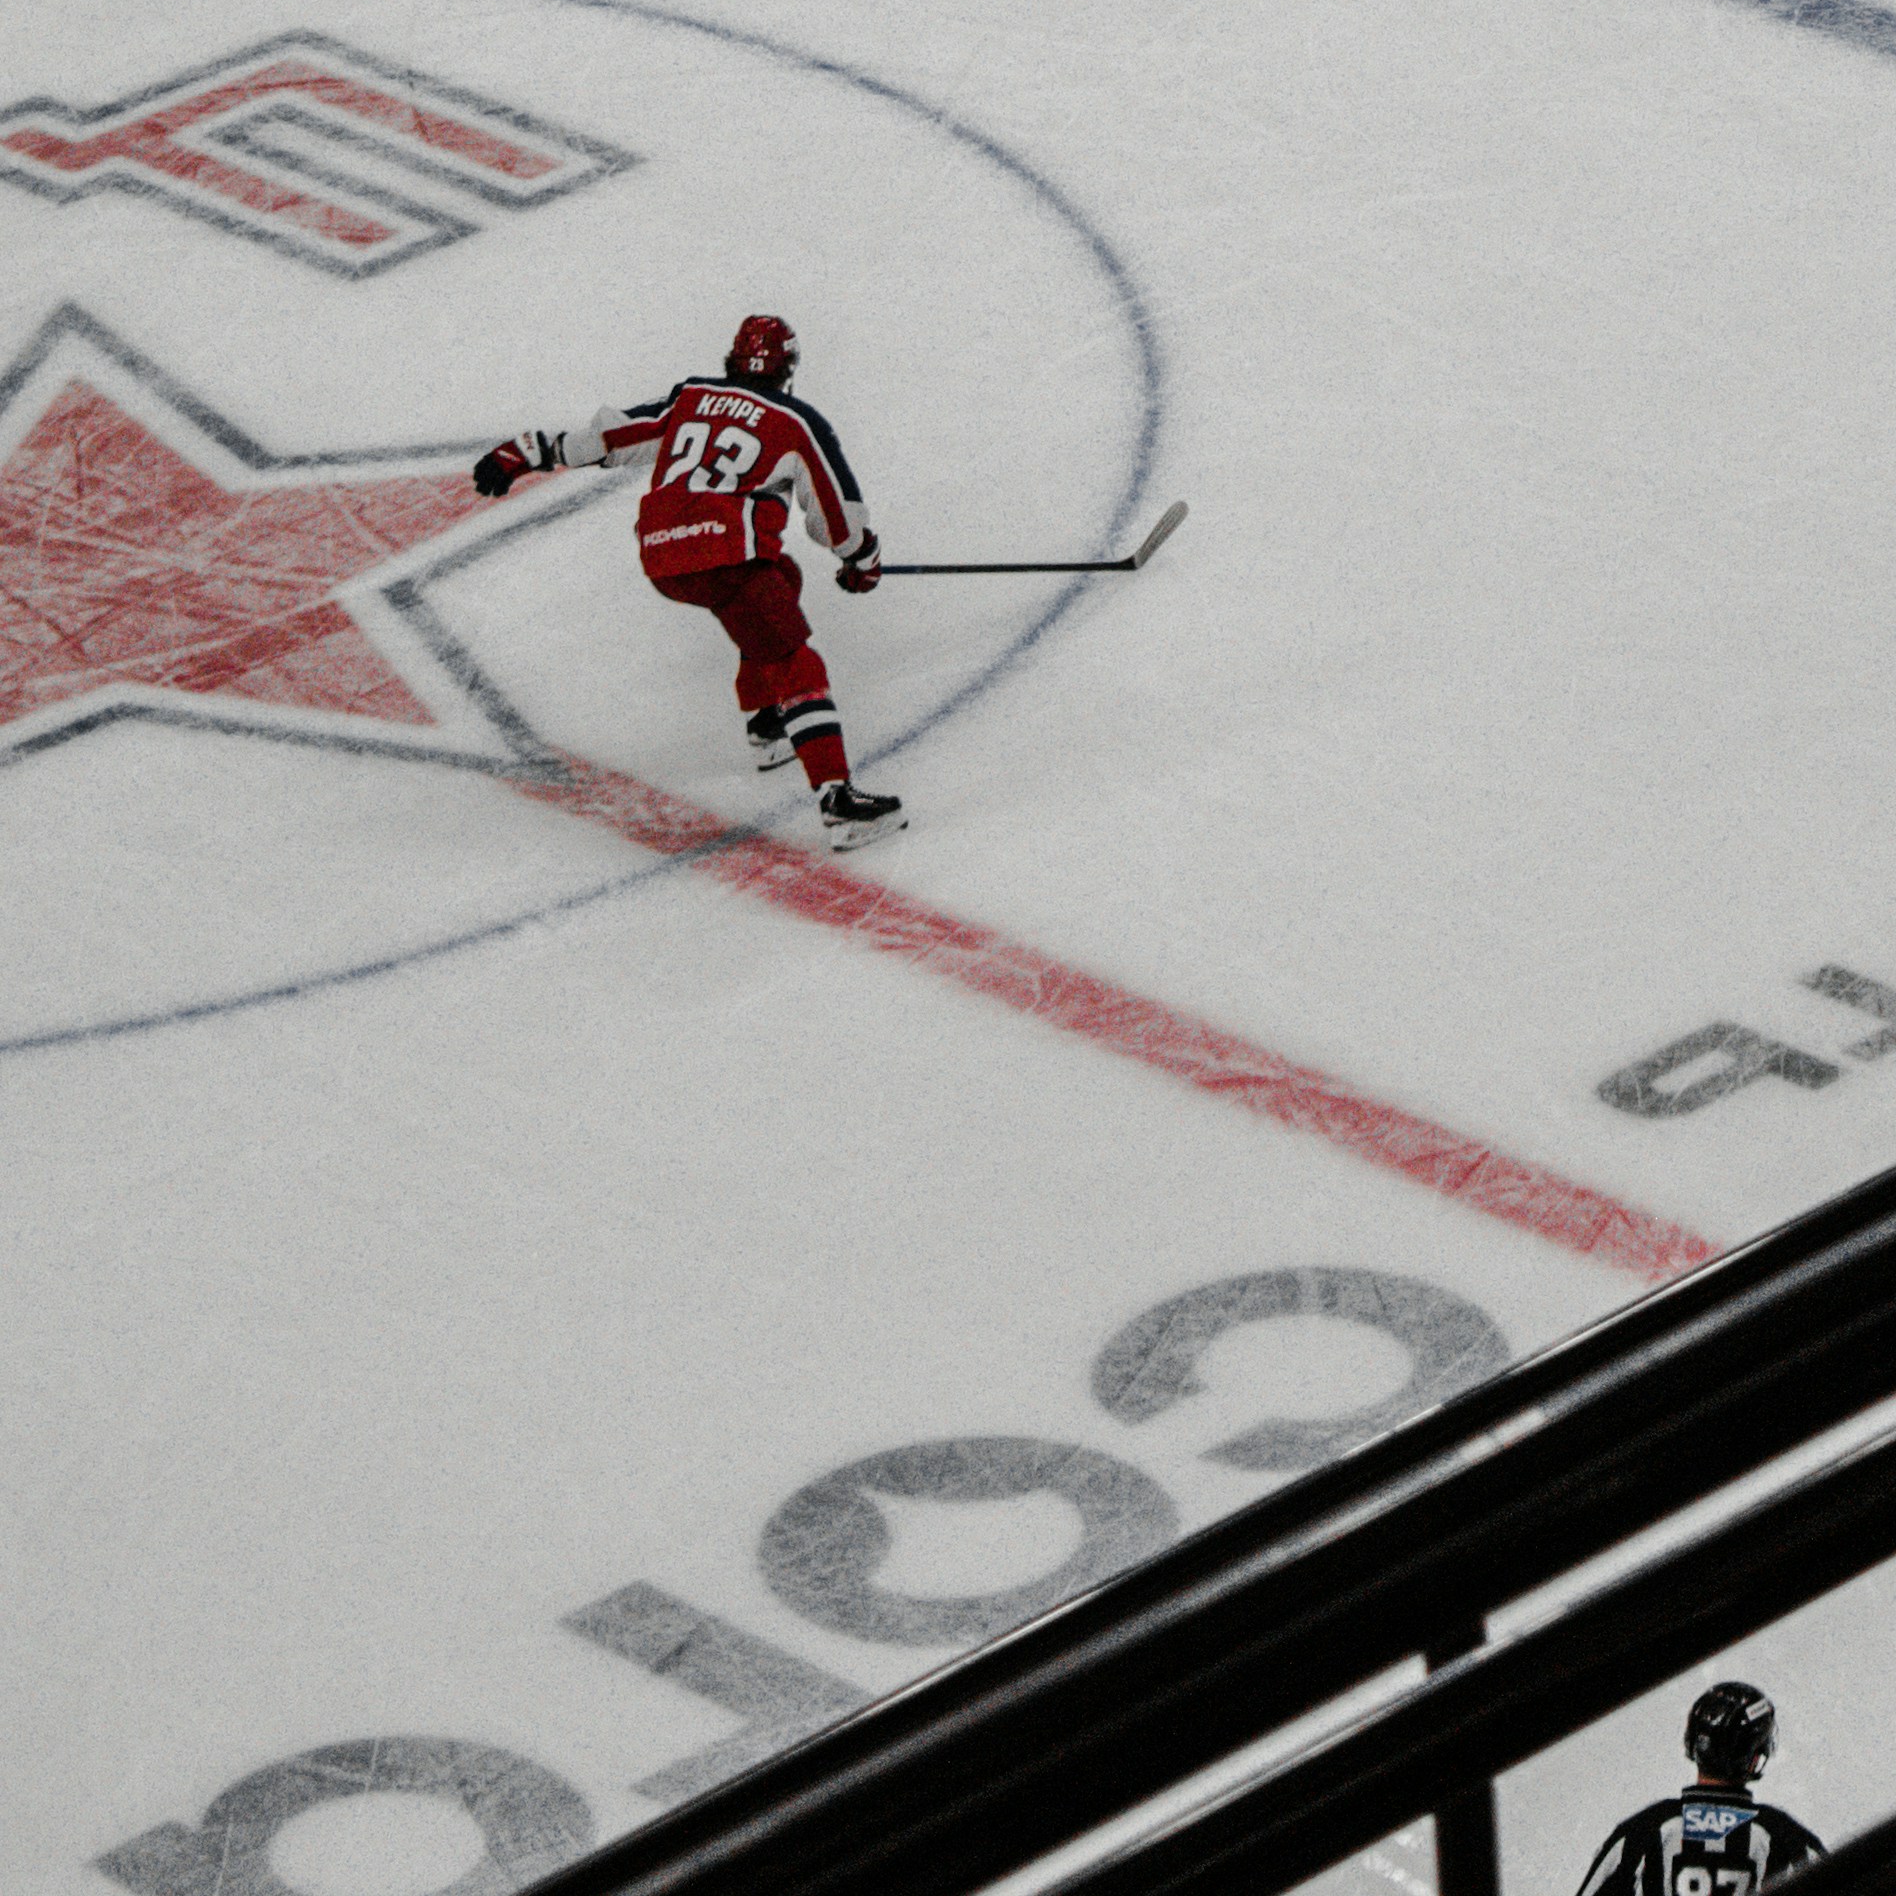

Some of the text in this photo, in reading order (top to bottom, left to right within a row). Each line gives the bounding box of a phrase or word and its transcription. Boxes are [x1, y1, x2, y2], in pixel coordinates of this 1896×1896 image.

[695, 393, 767, 429] KEMPE
[660, 420, 763, 495] 23
[1684, 1809, 1738, 1833] SAP
